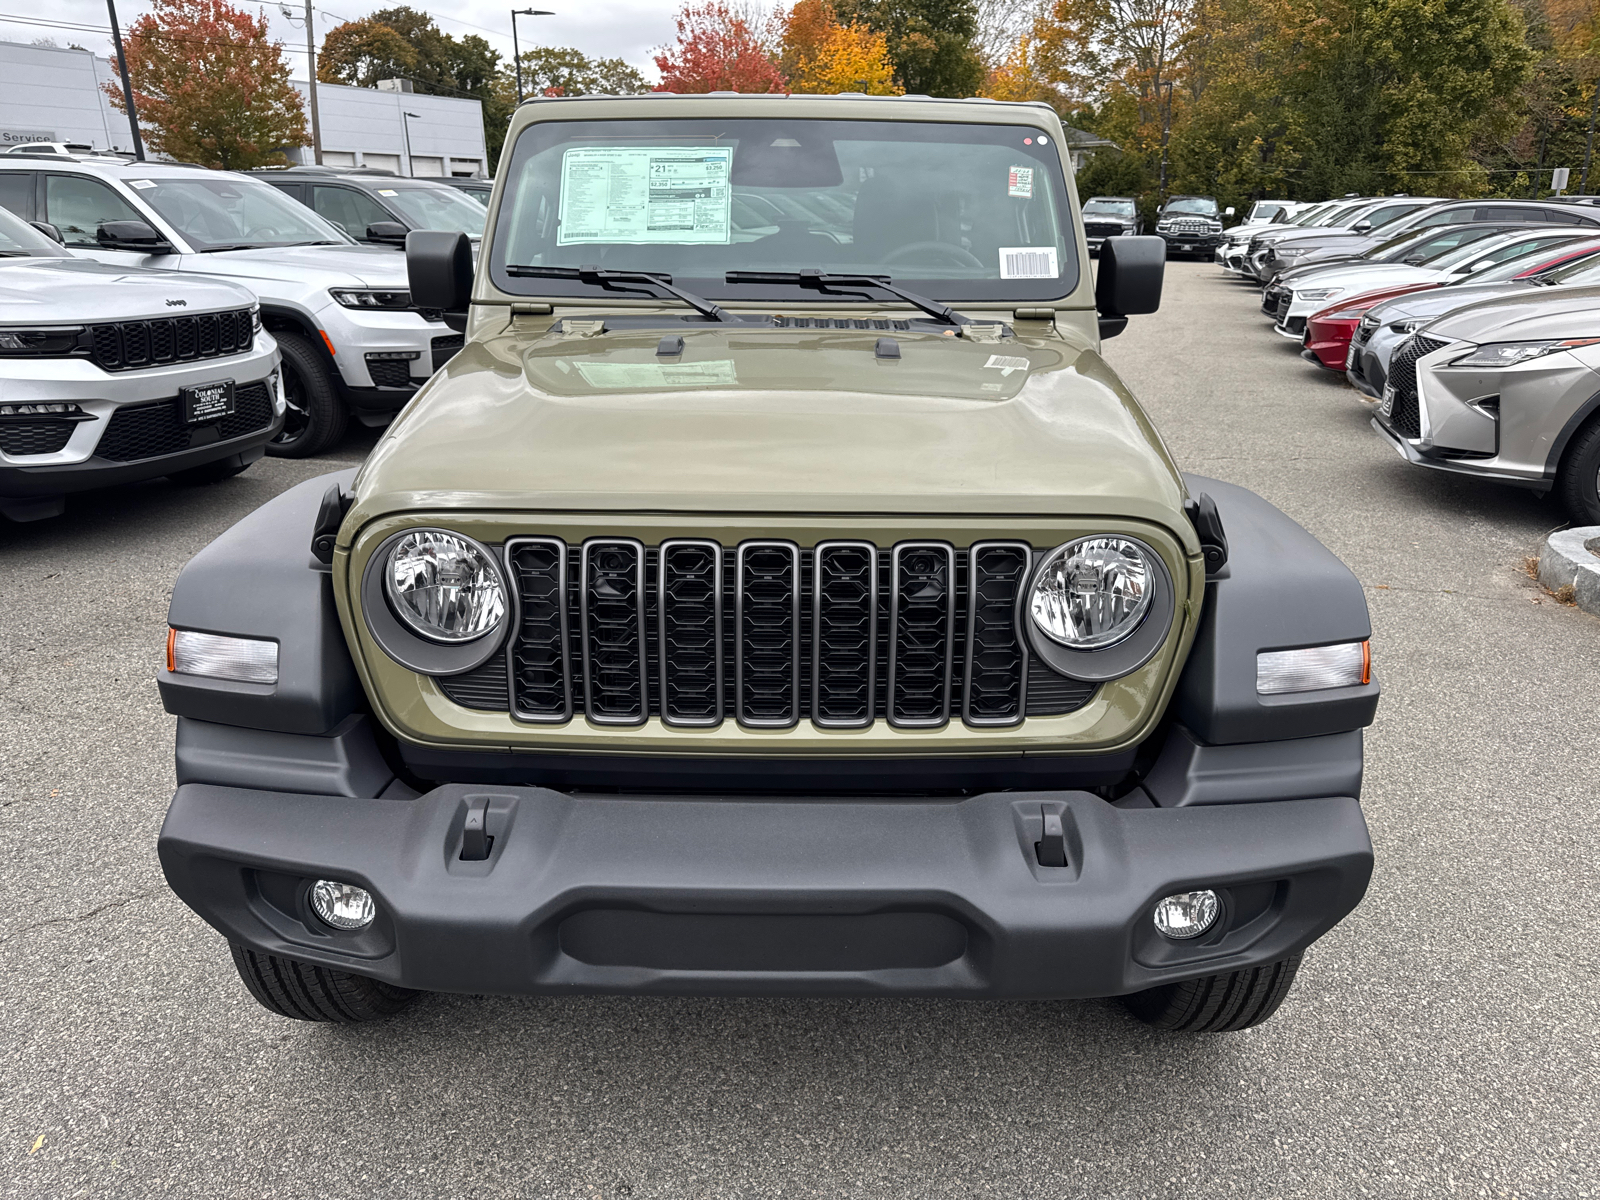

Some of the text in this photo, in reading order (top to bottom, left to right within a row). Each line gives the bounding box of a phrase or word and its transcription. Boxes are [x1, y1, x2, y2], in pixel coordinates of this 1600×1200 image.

[3, 132, 51, 142] Service
[655, 165, 666, 173] 21
[165, 299, 187, 307] Jeep
[200, 394, 220, 402] SOUTH
